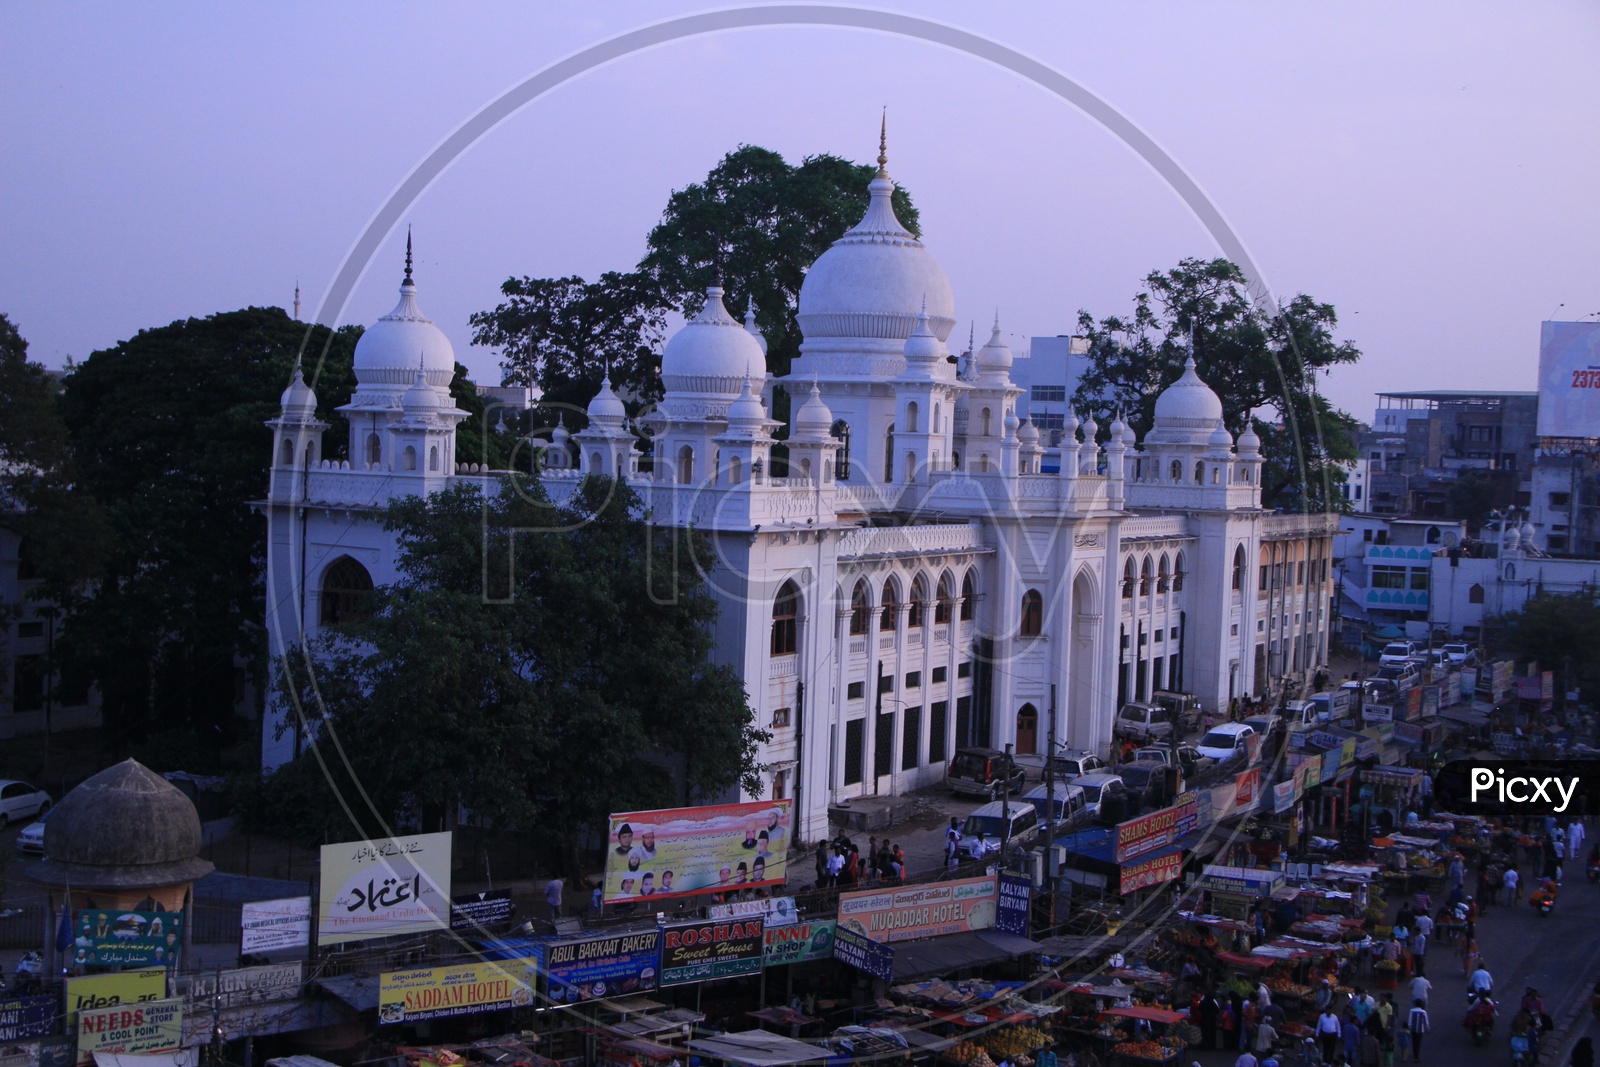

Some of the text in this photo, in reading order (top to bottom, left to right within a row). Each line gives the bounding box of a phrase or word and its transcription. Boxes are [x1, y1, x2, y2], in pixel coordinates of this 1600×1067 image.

[1572, 370, 1600, 388] 2373
[1120, 821, 1148, 844] SHAMS
[1150, 812, 1176, 834] HOTEL
[1121, 854, 1180, 879] SHAMS HOTEL
[348, 872, 420, 912] اعتماد
[1000, 882, 1030, 898] KALYANI
[1000, 895, 1028, 912] BIRYANI
[332, 905, 437, 926] The Etemaad Urdu Daily
[870, 903, 966, 932] MUQADDAR HOTEL
[665, 921, 762, 948] ROSHAN
[914, 928, 935, 938] BIRYANI
[550, 946, 576, 964] ABUL
[578, 940, 620, 960] BARKAAT
[621, 933, 659, 953] BAKERY
[672, 947, 710, 960] Sweet
[716, 942, 753, 955] House
[776, 941, 806, 954] SHOP
[834, 938, 866, 959] KALYANI
[834, 949, 865, 969] BIRYANI
[250, 977, 299, 989] CENTRE
[256, 969, 295, 980] TIFFIN
[76, 994, 120, 1010] Idea
[406, 984, 464, 1010] SADDAM
[467, 980, 512, 1002] HOTEL
[4, 1001, 22, 1010] HOTEL
[146, 1005, 178, 1016] GENERAL
[405, 1011, 420, 1022] Kalyani
[434, 1008, 450, 1018] Chicken
[454, 1006, 467, 1015] Mutton
[468, 1004, 480, 1014] Biryani
[484, 1002, 496, 1012] Family
[497, 1001, 511, 1010] Section
[83, 1009, 144, 1035] NEEDS
[150, 1014, 174, 1024] STORE
[101, 1033, 106, 1042] &
[110, 1030, 132, 1040] COOL
[135, 1025, 160, 1036] POINT
